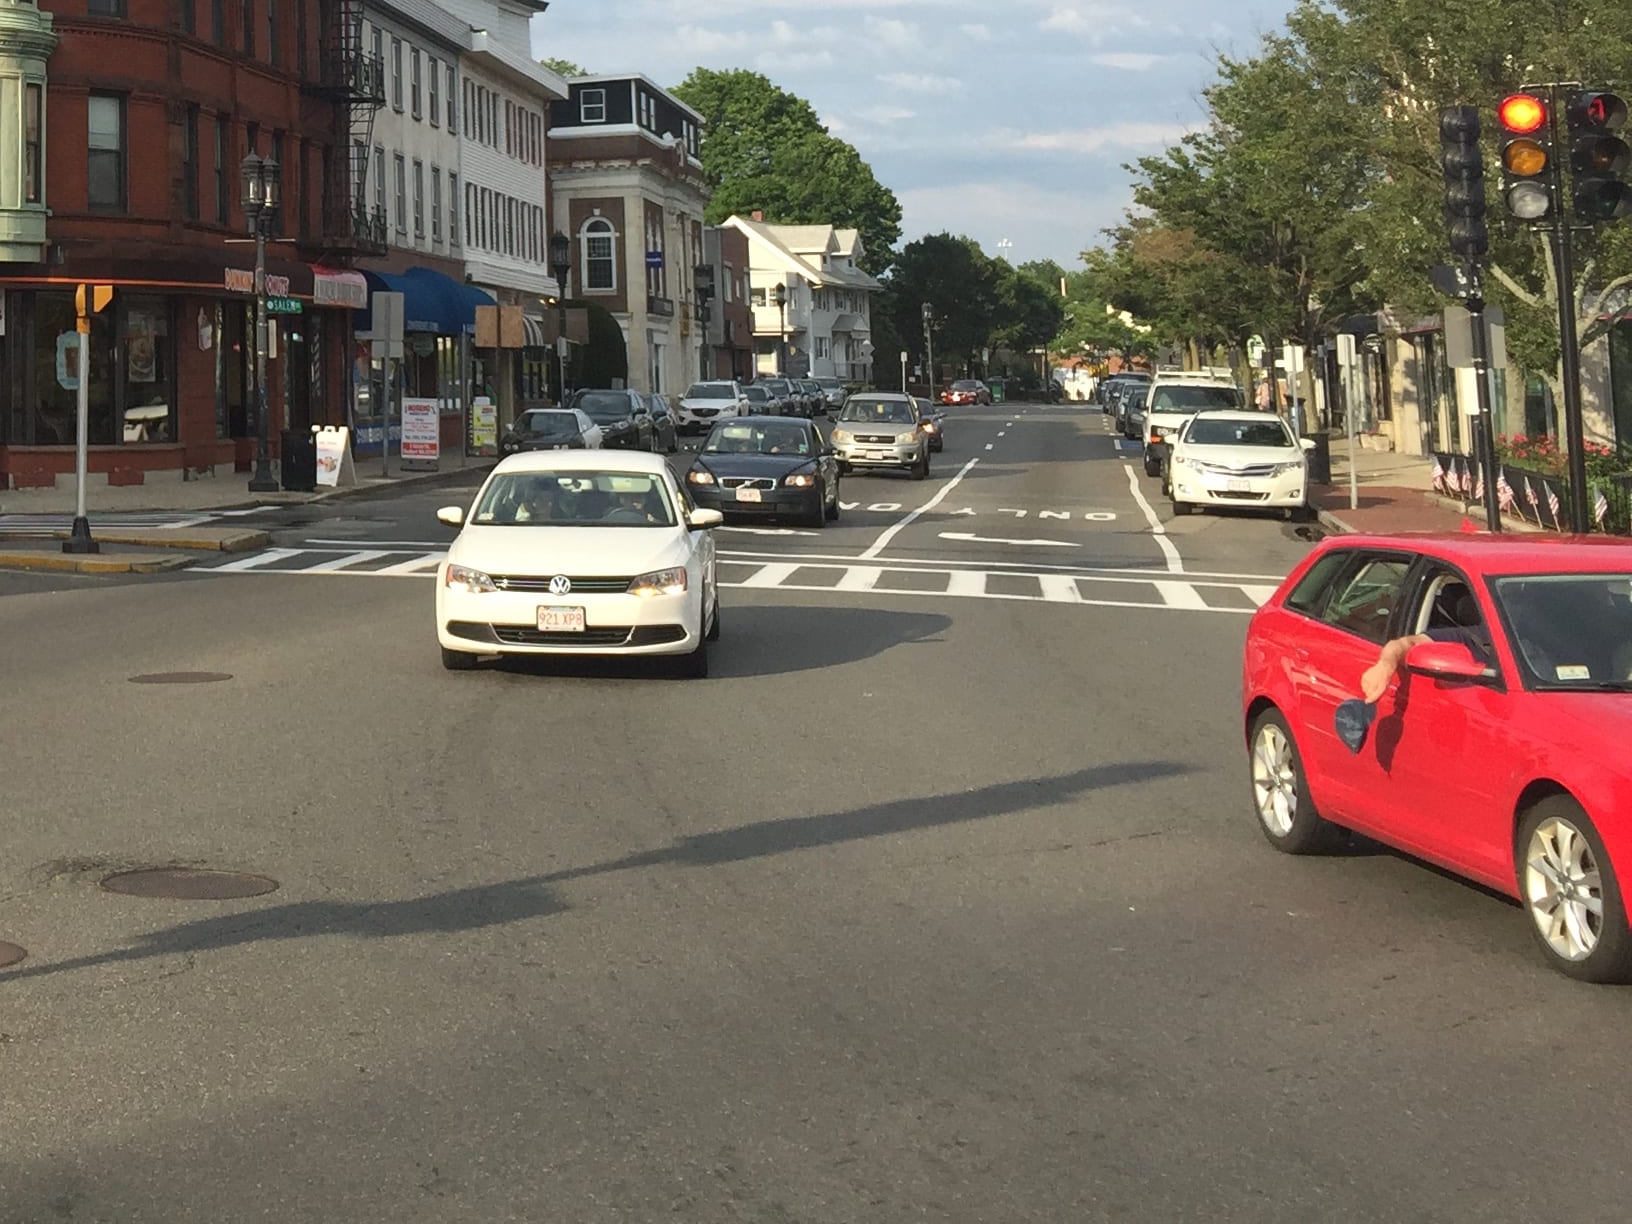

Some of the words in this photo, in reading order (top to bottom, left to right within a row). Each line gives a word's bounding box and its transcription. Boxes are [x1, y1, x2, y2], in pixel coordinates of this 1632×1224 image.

[274, 300, 296, 312] SALEM
[950, 507, 1117, 522] ONLY
[539, 613, 560, 626] 921
